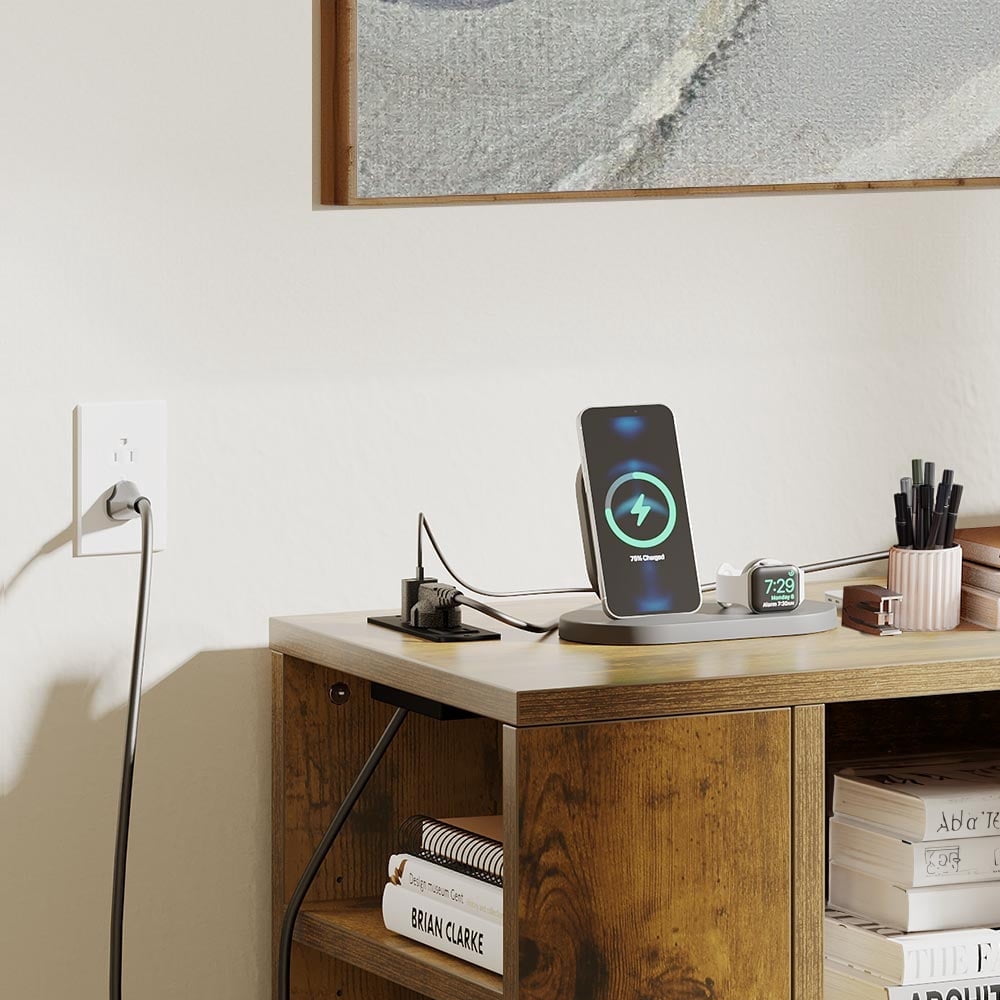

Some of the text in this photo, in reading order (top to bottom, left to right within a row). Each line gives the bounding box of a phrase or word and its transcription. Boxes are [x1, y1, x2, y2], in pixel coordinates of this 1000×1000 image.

[764, 578, 795, 595] 7:29
[411, 907, 443, 939] BRIAN
[446, 921, 484, 955] CLARKE
[908, 944, 968, 979] THE
